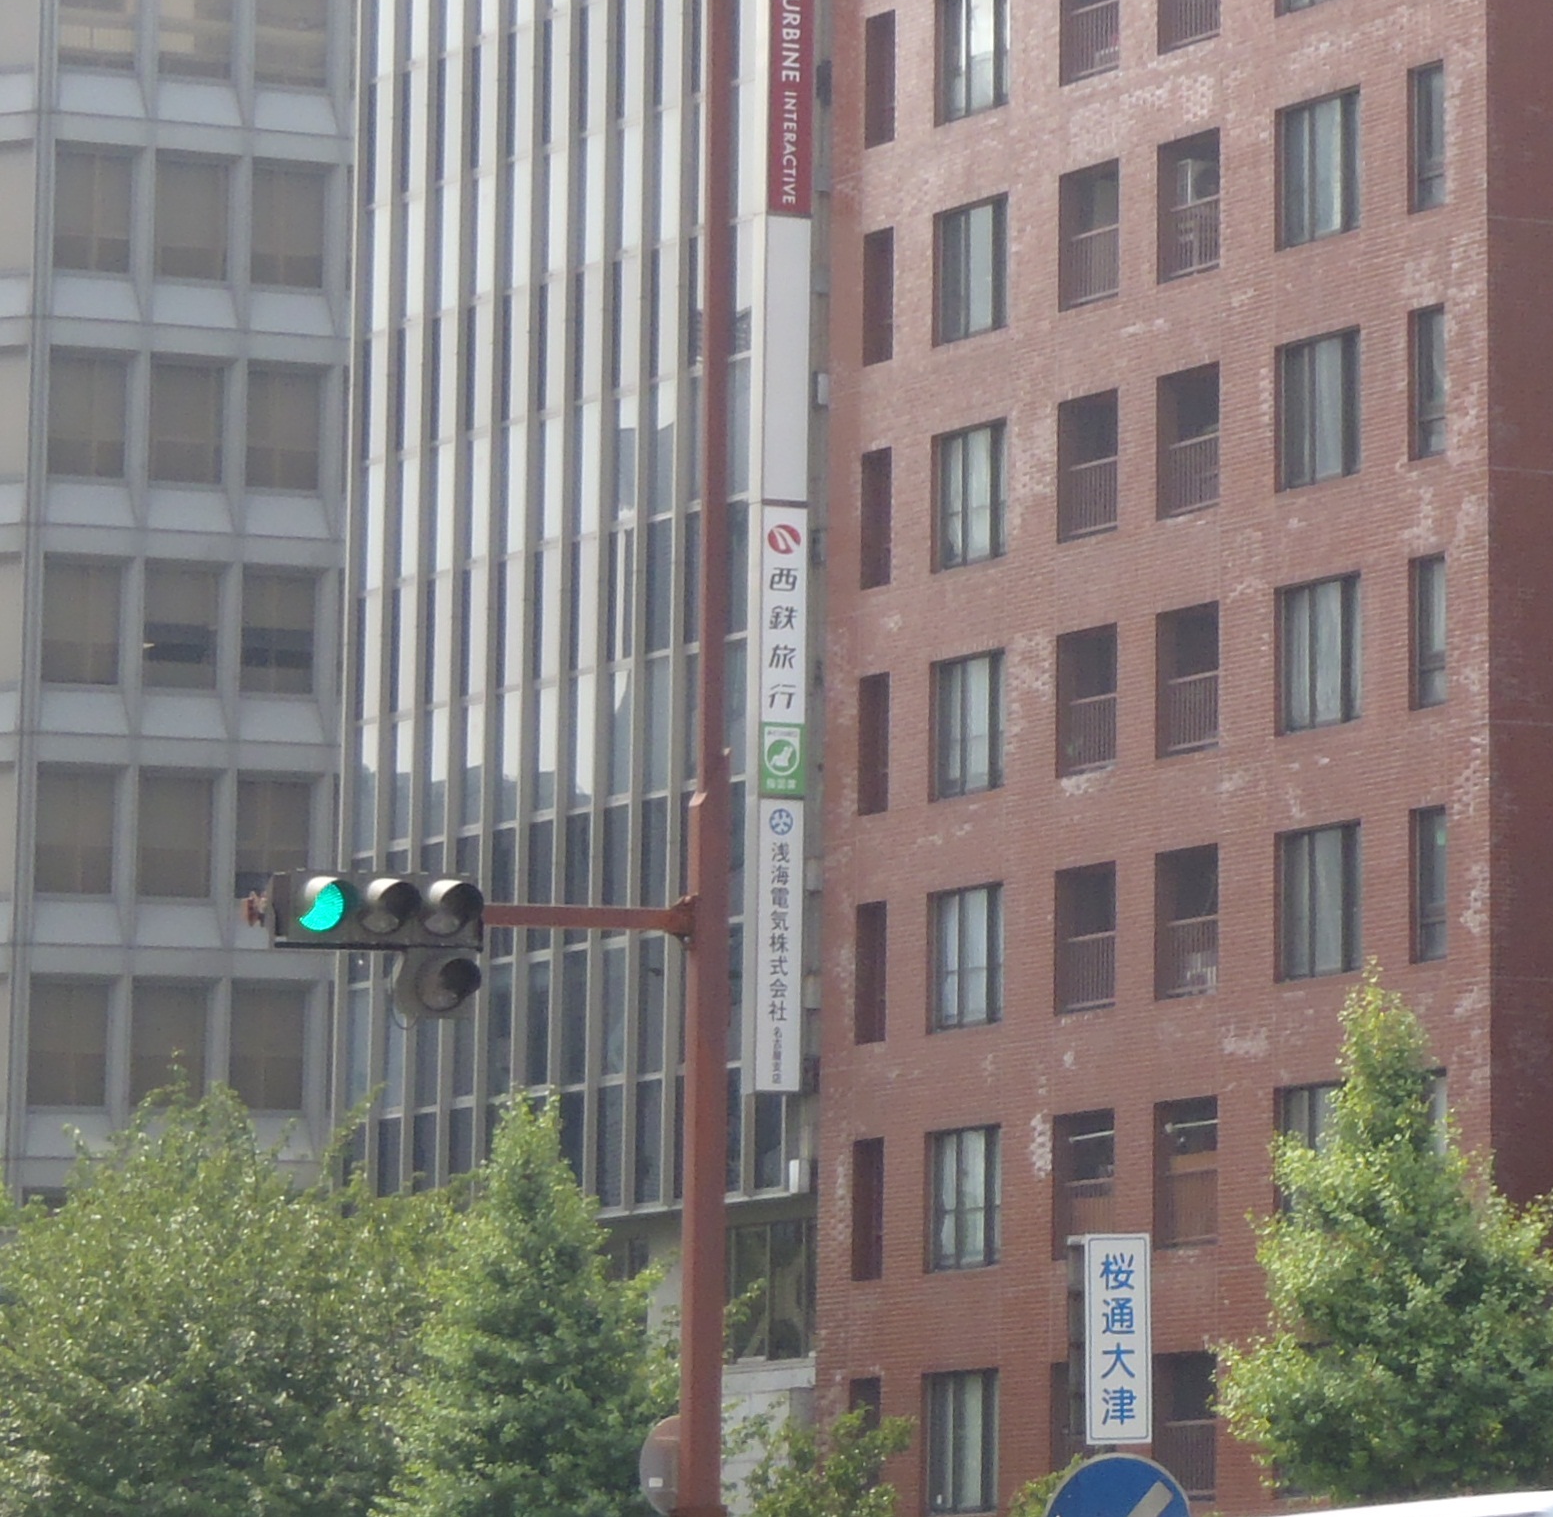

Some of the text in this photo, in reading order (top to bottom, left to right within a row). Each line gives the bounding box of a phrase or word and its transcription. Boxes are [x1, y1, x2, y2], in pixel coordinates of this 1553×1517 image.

[782, 91, 797, 205] INTERACTIVE
[768, 567, 798, 710] 西鉄旅行
[769, 842, 789, 1021] 浅海電気株式会社
[1099, 1252, 1137, 1426] 桜通大津
